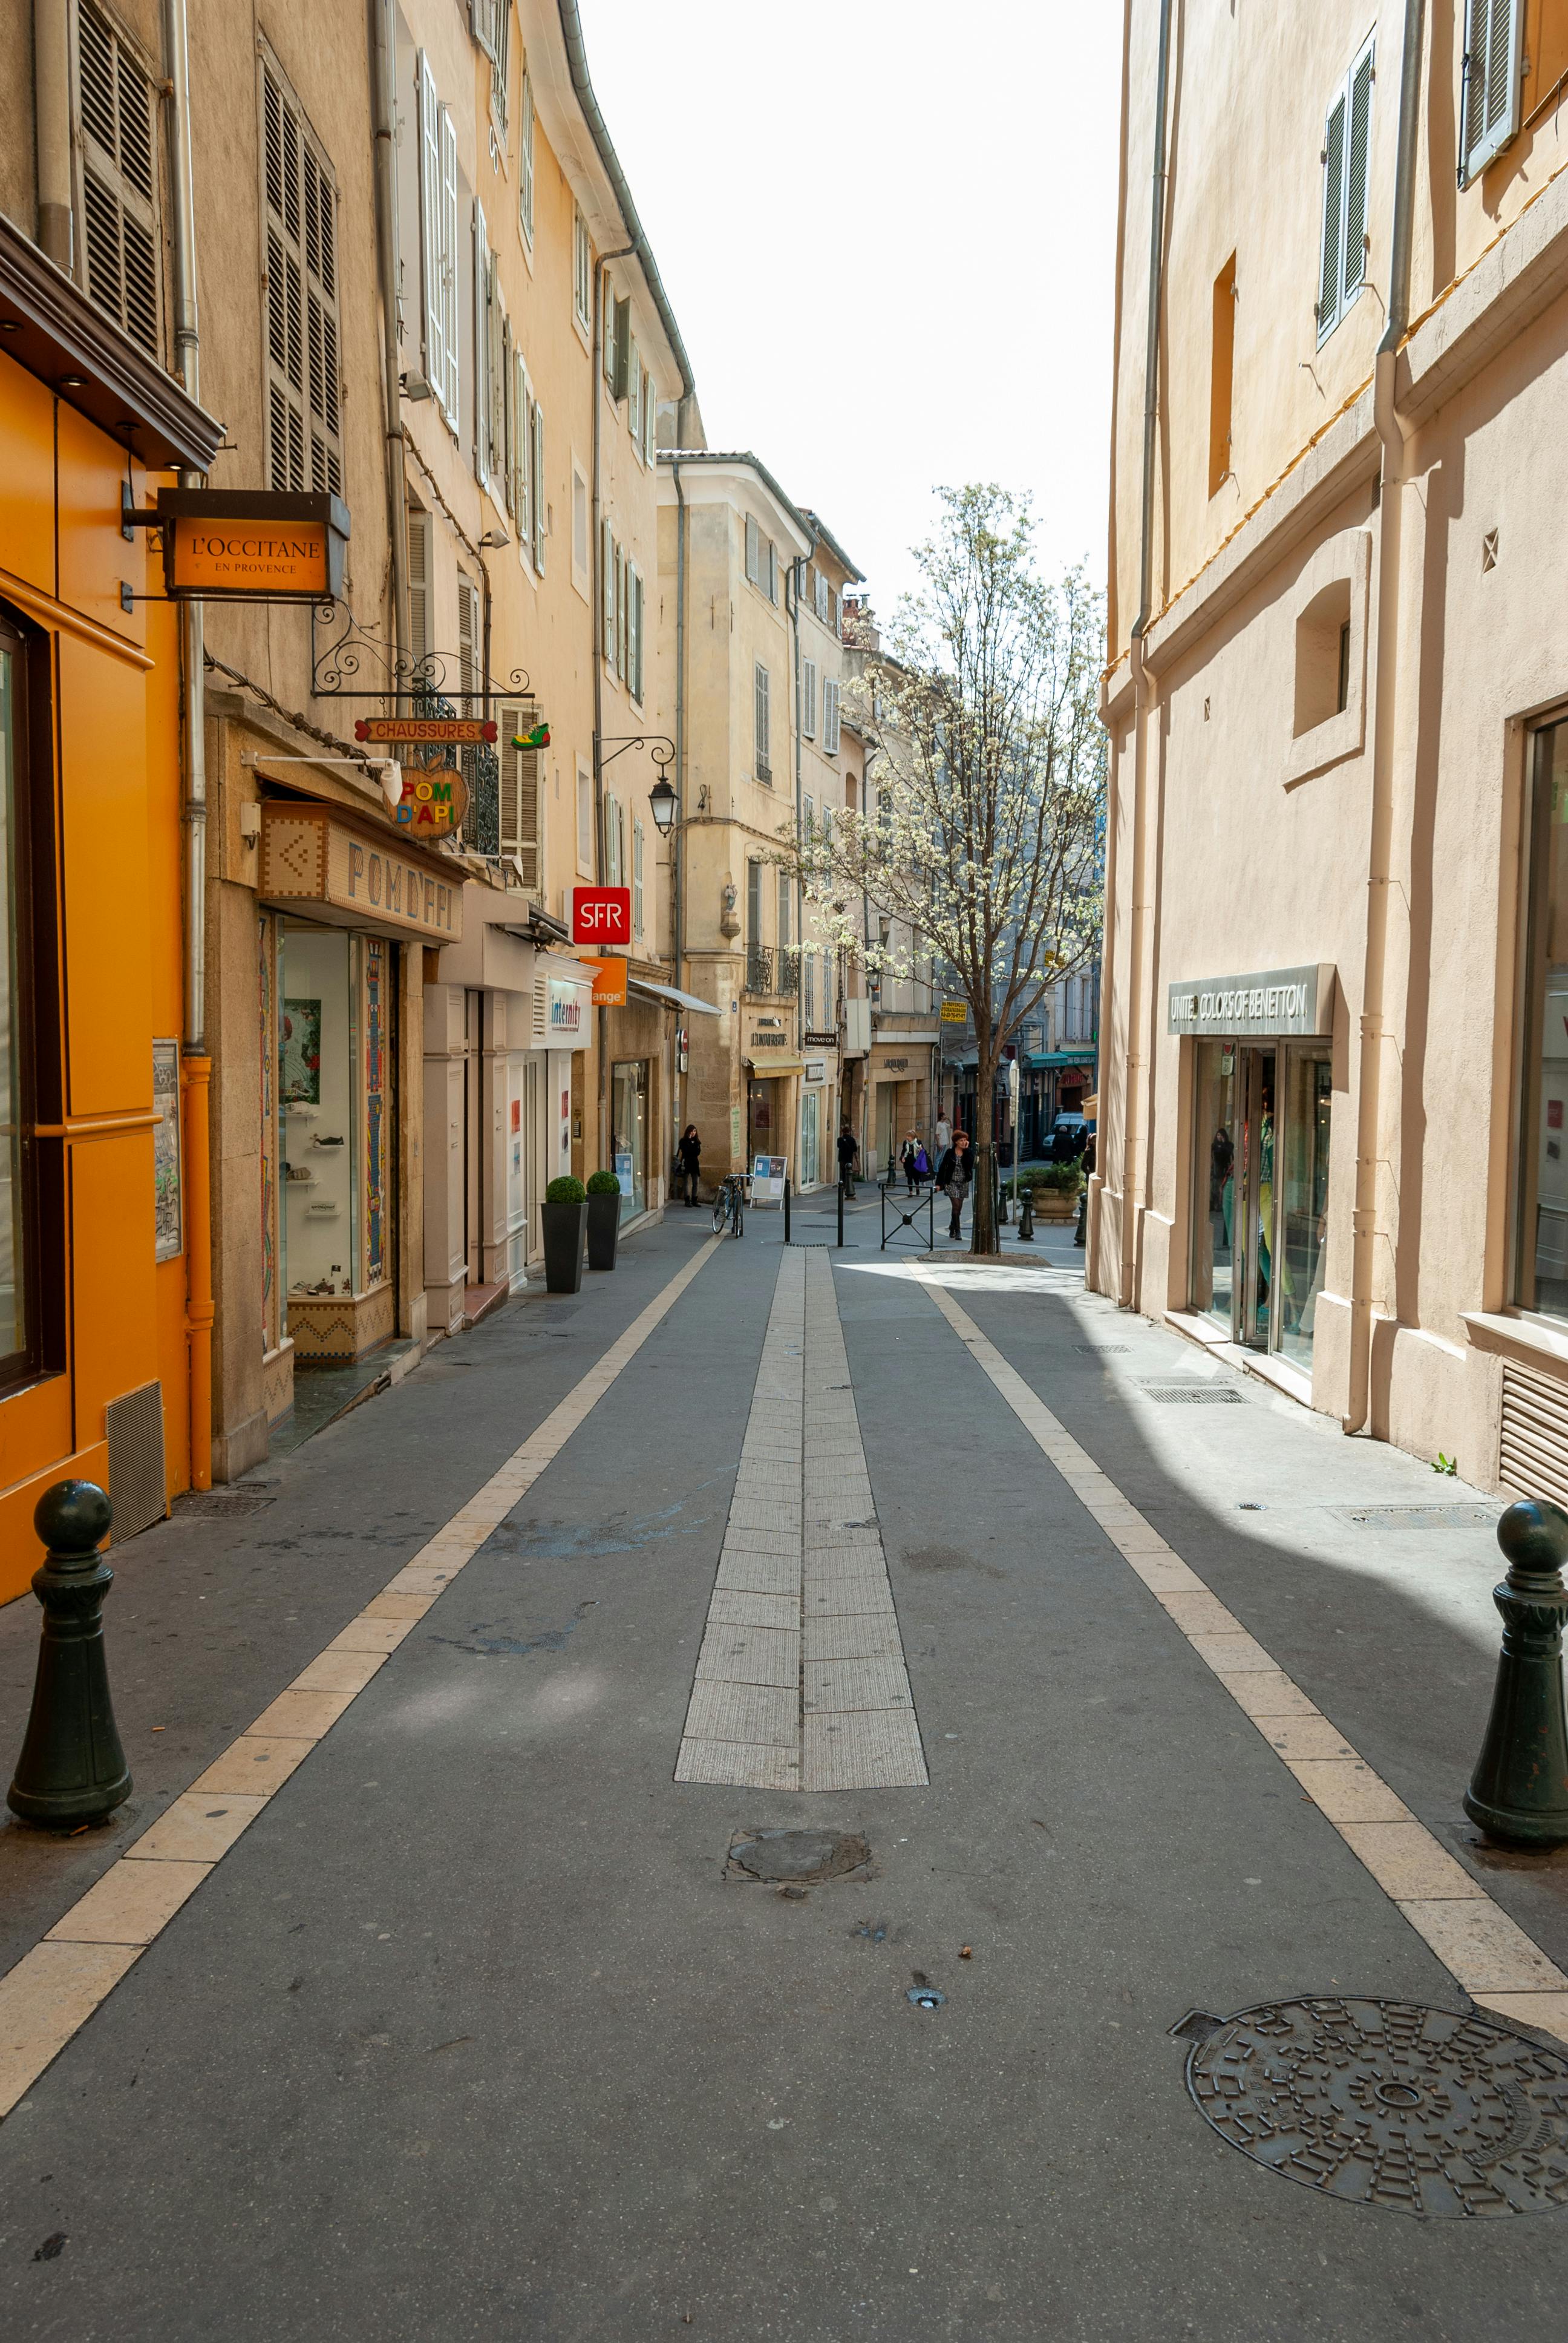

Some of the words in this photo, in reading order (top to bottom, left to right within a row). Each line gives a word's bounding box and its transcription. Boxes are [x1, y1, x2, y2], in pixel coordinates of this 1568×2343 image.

[192, 537, 320, 559] L'OCCITANE
[215, 563, 230, 571] EN
[235, 563, 296, 574] PROVENCE
[376, 723, 476, 738] CHAUSSURES
[400, 782, 452, 801] POM
[397, 805, 454, 824] D'API
[580, 903, 622, 928] SFR
[592, 992, 621, 1004] ange
[551, 993, 581, 1032] internity
[1171, 995, 1198, 1021] UNITED
